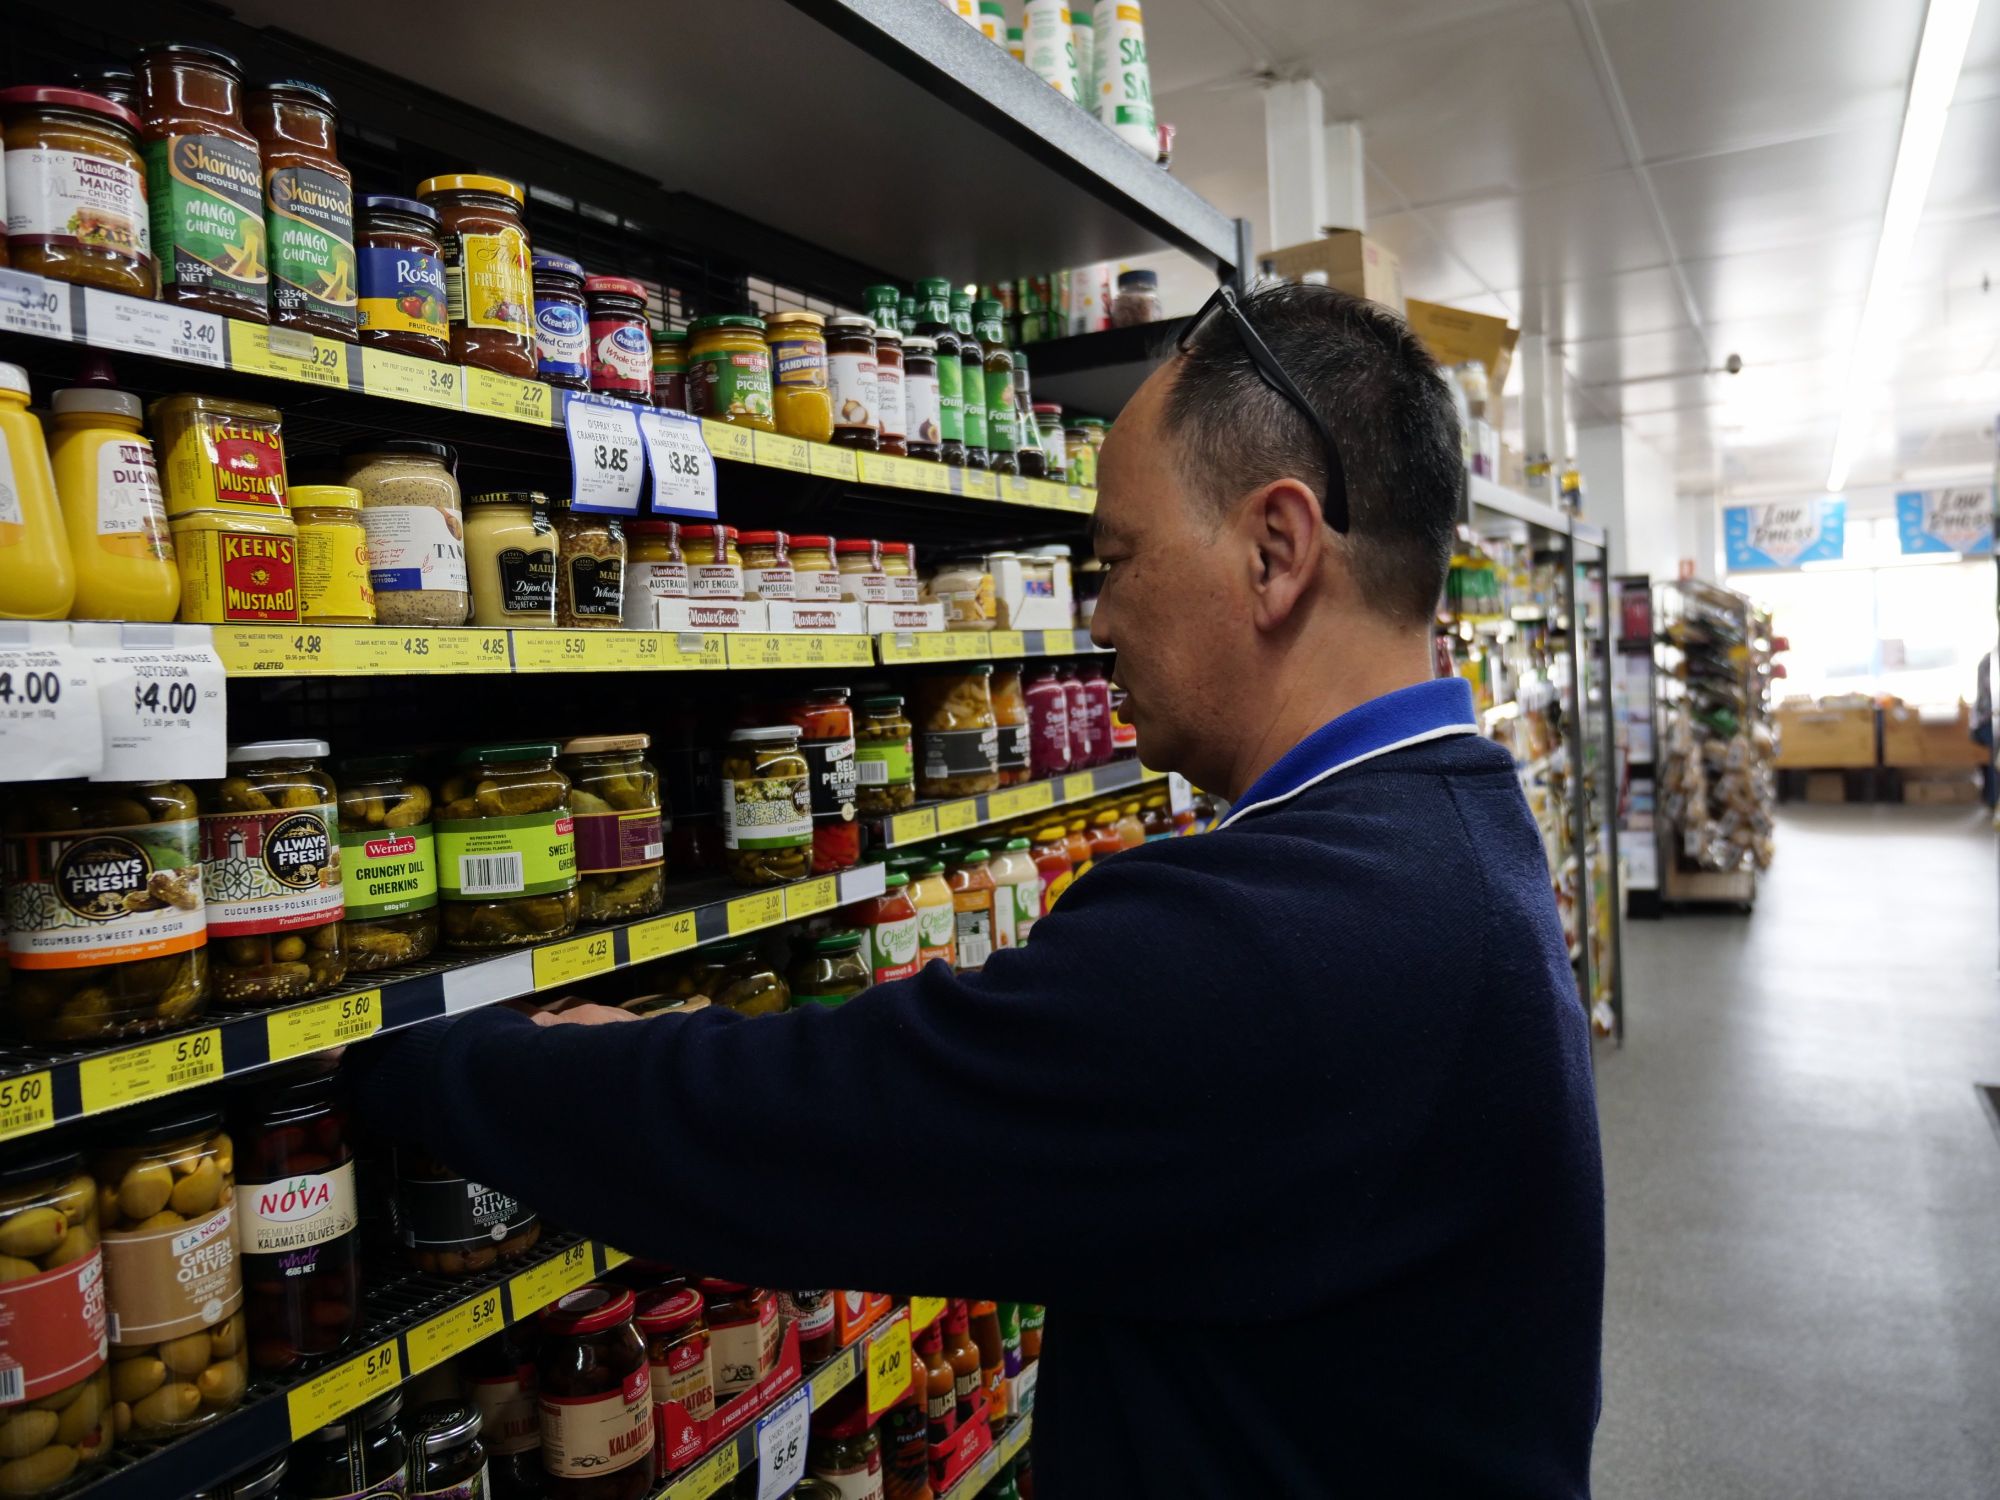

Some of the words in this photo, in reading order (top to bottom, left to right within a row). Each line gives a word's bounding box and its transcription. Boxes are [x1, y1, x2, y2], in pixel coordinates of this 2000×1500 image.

[80, 176, 132, 199] MANGO
[196, 172, 239, 192] DISCOVER
[240, 186, 262, 200] INDIA
[88, 190, 128, 204] CHUTNEY
[185, 200, 236, 226] MANGO
[290, 203, 329, 219] DISCOVER
[331, 214, 351, 227] INDIA
[185, 219, 237, 241] CHUTNEY
[281, 229, 328, 253] MANGO
[282, 247, 329, 267] CHUTNEY
[548, 260, 563, 269] EASY
[564, 262, 578, 271] OPEN
[180, 273, 204, 283] NET
[212, 278, 236, 291] GREEN
[238, 284, 258, 296] LABEL
[278, 298, 300, 308] NET
[408, 321, 427, 330] FRUIT
[542, 315, 562, 327] Ocean
[183, 320, 215, 343] 3.40
[606, 347, 629, 364] Whole
[779, 357, 820, 372] SANDWICH
[430, 369, 453, 389] 3.49
[577, 430, 609, 443] CRANBERRY
[594, 445, 628, 472] $3.85
[669, 451, 699, 476] $3.85
[218, 467, 285, 497] MUSTARD
[471, 492, 510, 503] MAILLE
[1763, 503, 1802, 527] Low
[104, 520, 118, 529] 250
[224, 537, 292, 564] KEEN'S
[512, 580, 540, 596] Dijon
[693, 580, 709, 589] HOT
[712, 580, 738, 588] ENGLISH
[815, 585, 829, 593] MILD
[227, 586, 295, 611] MUSTARD
[258, 611, 268, 619] 50g
[295, 635, 321, 653] 4.98
[404, 638, 429, 655] 4.35
[482, 638, 504, 654] 4.85
[565, 638, 585, 653] 5.50
[640, 638, 657, 653] 5.50
[113, 656, 160, 664] MUSTARD
[253, 662, 284, 670] DELETED
[135, 681, 196, 715] $4.00
[164, 720, 174, 728] per
[836, 759, 854, 772] RED
[822, 770, 856, 785] PEPPE
[273, 835, 327, 853] ALWAYS
[369, 841, 414, 855] Werner's
[549, 843, 568, 857] SWEET
[279, 850, 324, 866] FRESH
[66, 859, 142, 879] ALWAYS
[356, 864, 405, 880] CRUNCHY
[408, 861, 424, 874] DILL
[72, 876, 138, 893] FRESH
[369, 878, 418, 895] GHERKINS
[224, 898, 317, 916] CUCUMBERS-POLSKIE
[279, 913, 316, 925] Traditional
[674, 919, 689, 934] 4.82
[138, 927, 158, 937] AND
[162, 922, 183, 933] SOUR
[588, 939, 607, 956] 4.23
[342, 997, 370, 1019] 5.60
[176, 1036, 210, 1062] 5.60
[1, 1079, 41, 1108] 5.60
[287, 1178, 308, 1194] LA
[260, 1183, 330, 1214] NOVA
[180, 1235, 199, 1249] LA
[201, 1215, 227, 1239] NOVA
[257, 1224, 294, 1238] PREMIUM
[295, 1216, 333, 1234] SELECTION
[258, 1234, 305, 1249] KALAMATA
[307, 1225, 335, 1242] OLIVES
[180, 1236, 231, 1267] GREEN
[177, 1249, 234, 1282] OLIVES
[303, 1263, 316, 1273] NET
[84, 1269, 96, 1283] LA
[473, 1297, 495, 1323] 5.30
[367, 1348, 391, 1375] 5.10
[963, 1430, 975, 1446] HOT
[774, 1437, 799, 1471] $5.15
[960, 1438, 979, 1461] SAUCE
